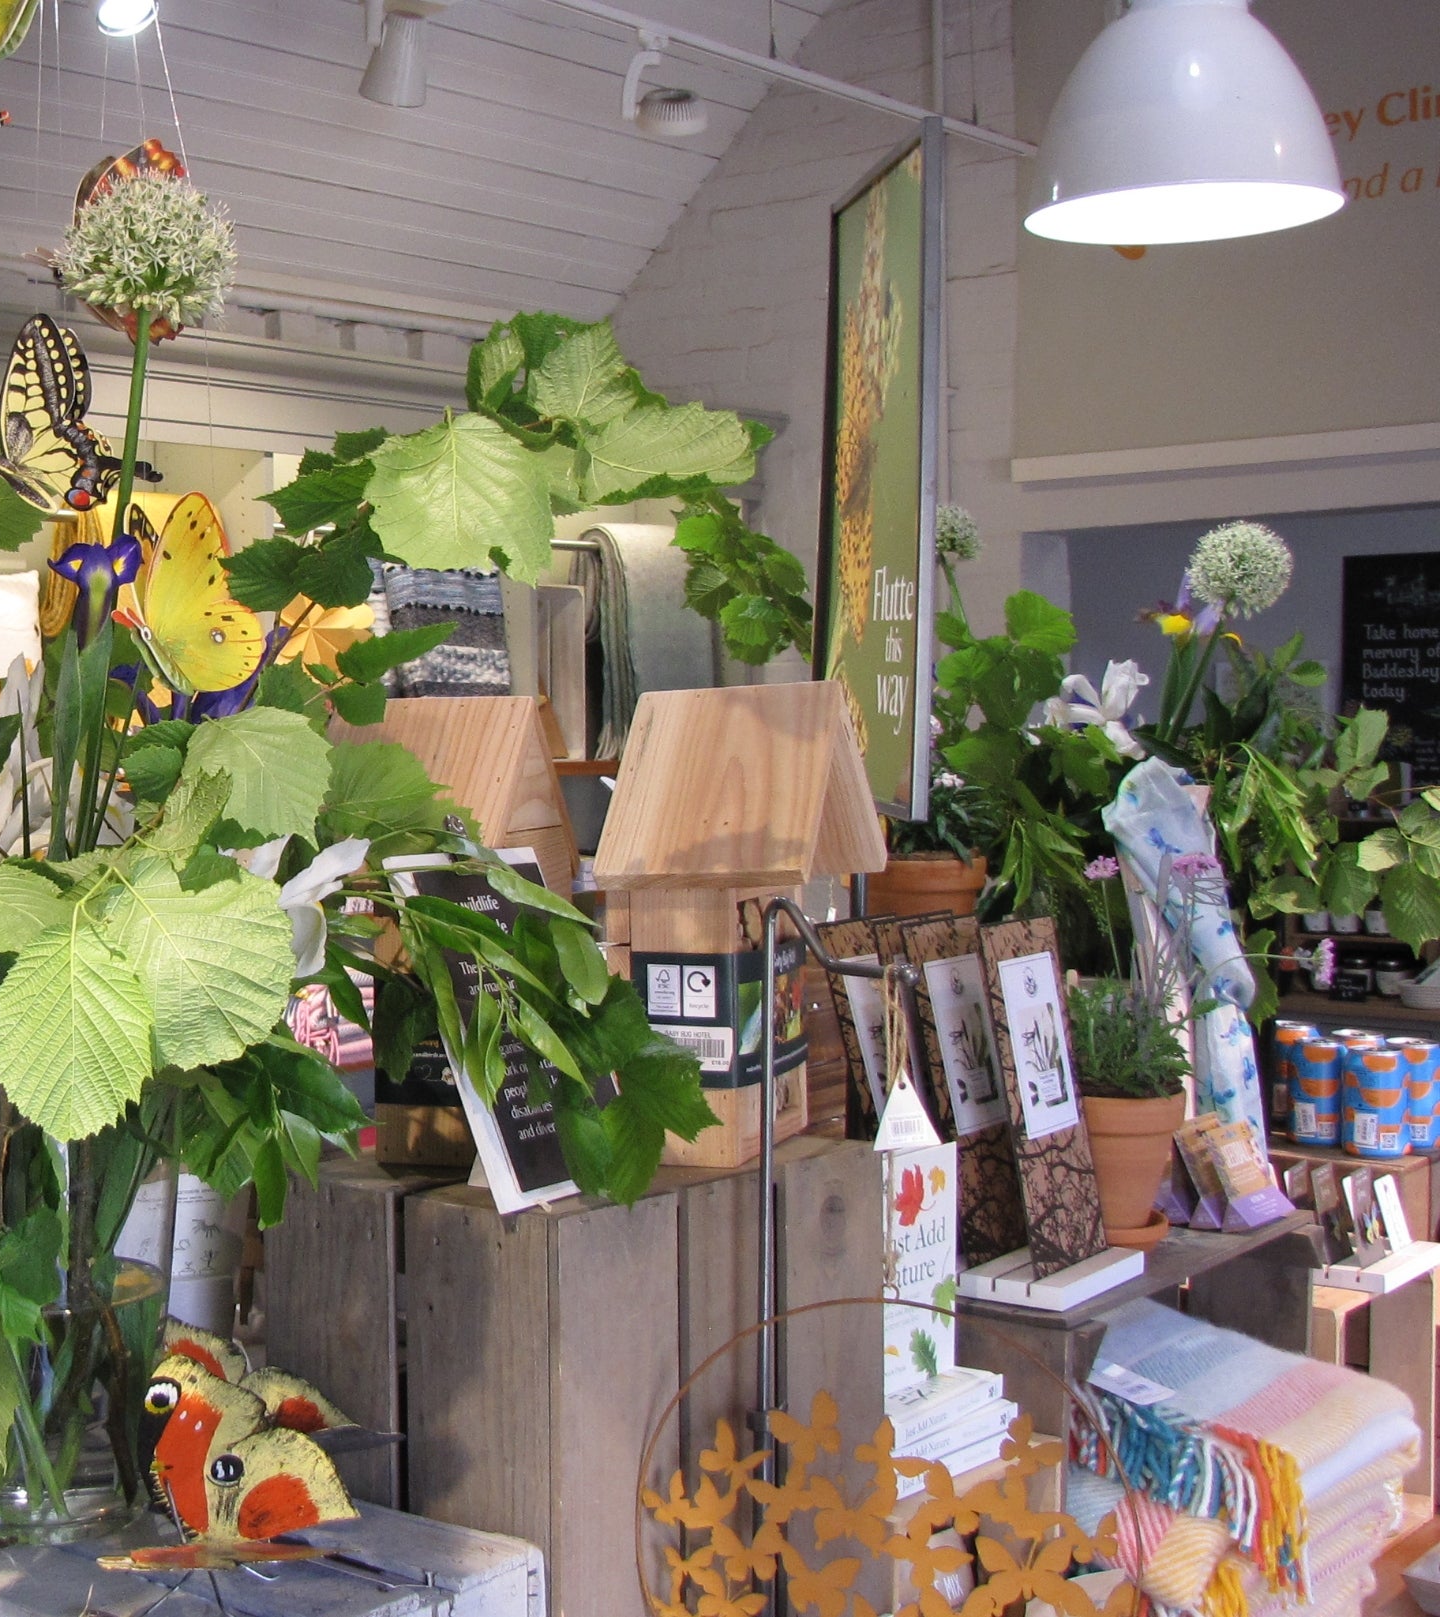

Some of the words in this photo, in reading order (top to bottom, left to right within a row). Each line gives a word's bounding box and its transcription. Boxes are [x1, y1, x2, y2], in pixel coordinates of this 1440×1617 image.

[1323, 107, 1365, 142] ey
[1376, 86, 1440, 126] Cli
[1343, 163, 1389, 199] nd
[1401, 167, 1424, 193] a
[873, 565, 914, 622] Flutte
[1363, 624, 1396, 640] Take
[1403, 623, 1440, 639] home
[885, 627, 902, 663] this
[1362, 647, 1419, 664] memory
[1362, 662, 1440, 683] Baddesley
[1362, 682, 1405, 703] today
[876, 674, 908, 736] way
[458, 961, 487, 975] Thee
[693, 1031, 711, 1039] HOTEL
[503, 1081, 528, 1102] peopl
[518, 1124, 535, 1140] and
[915, 1216, 946, 1251] Add
